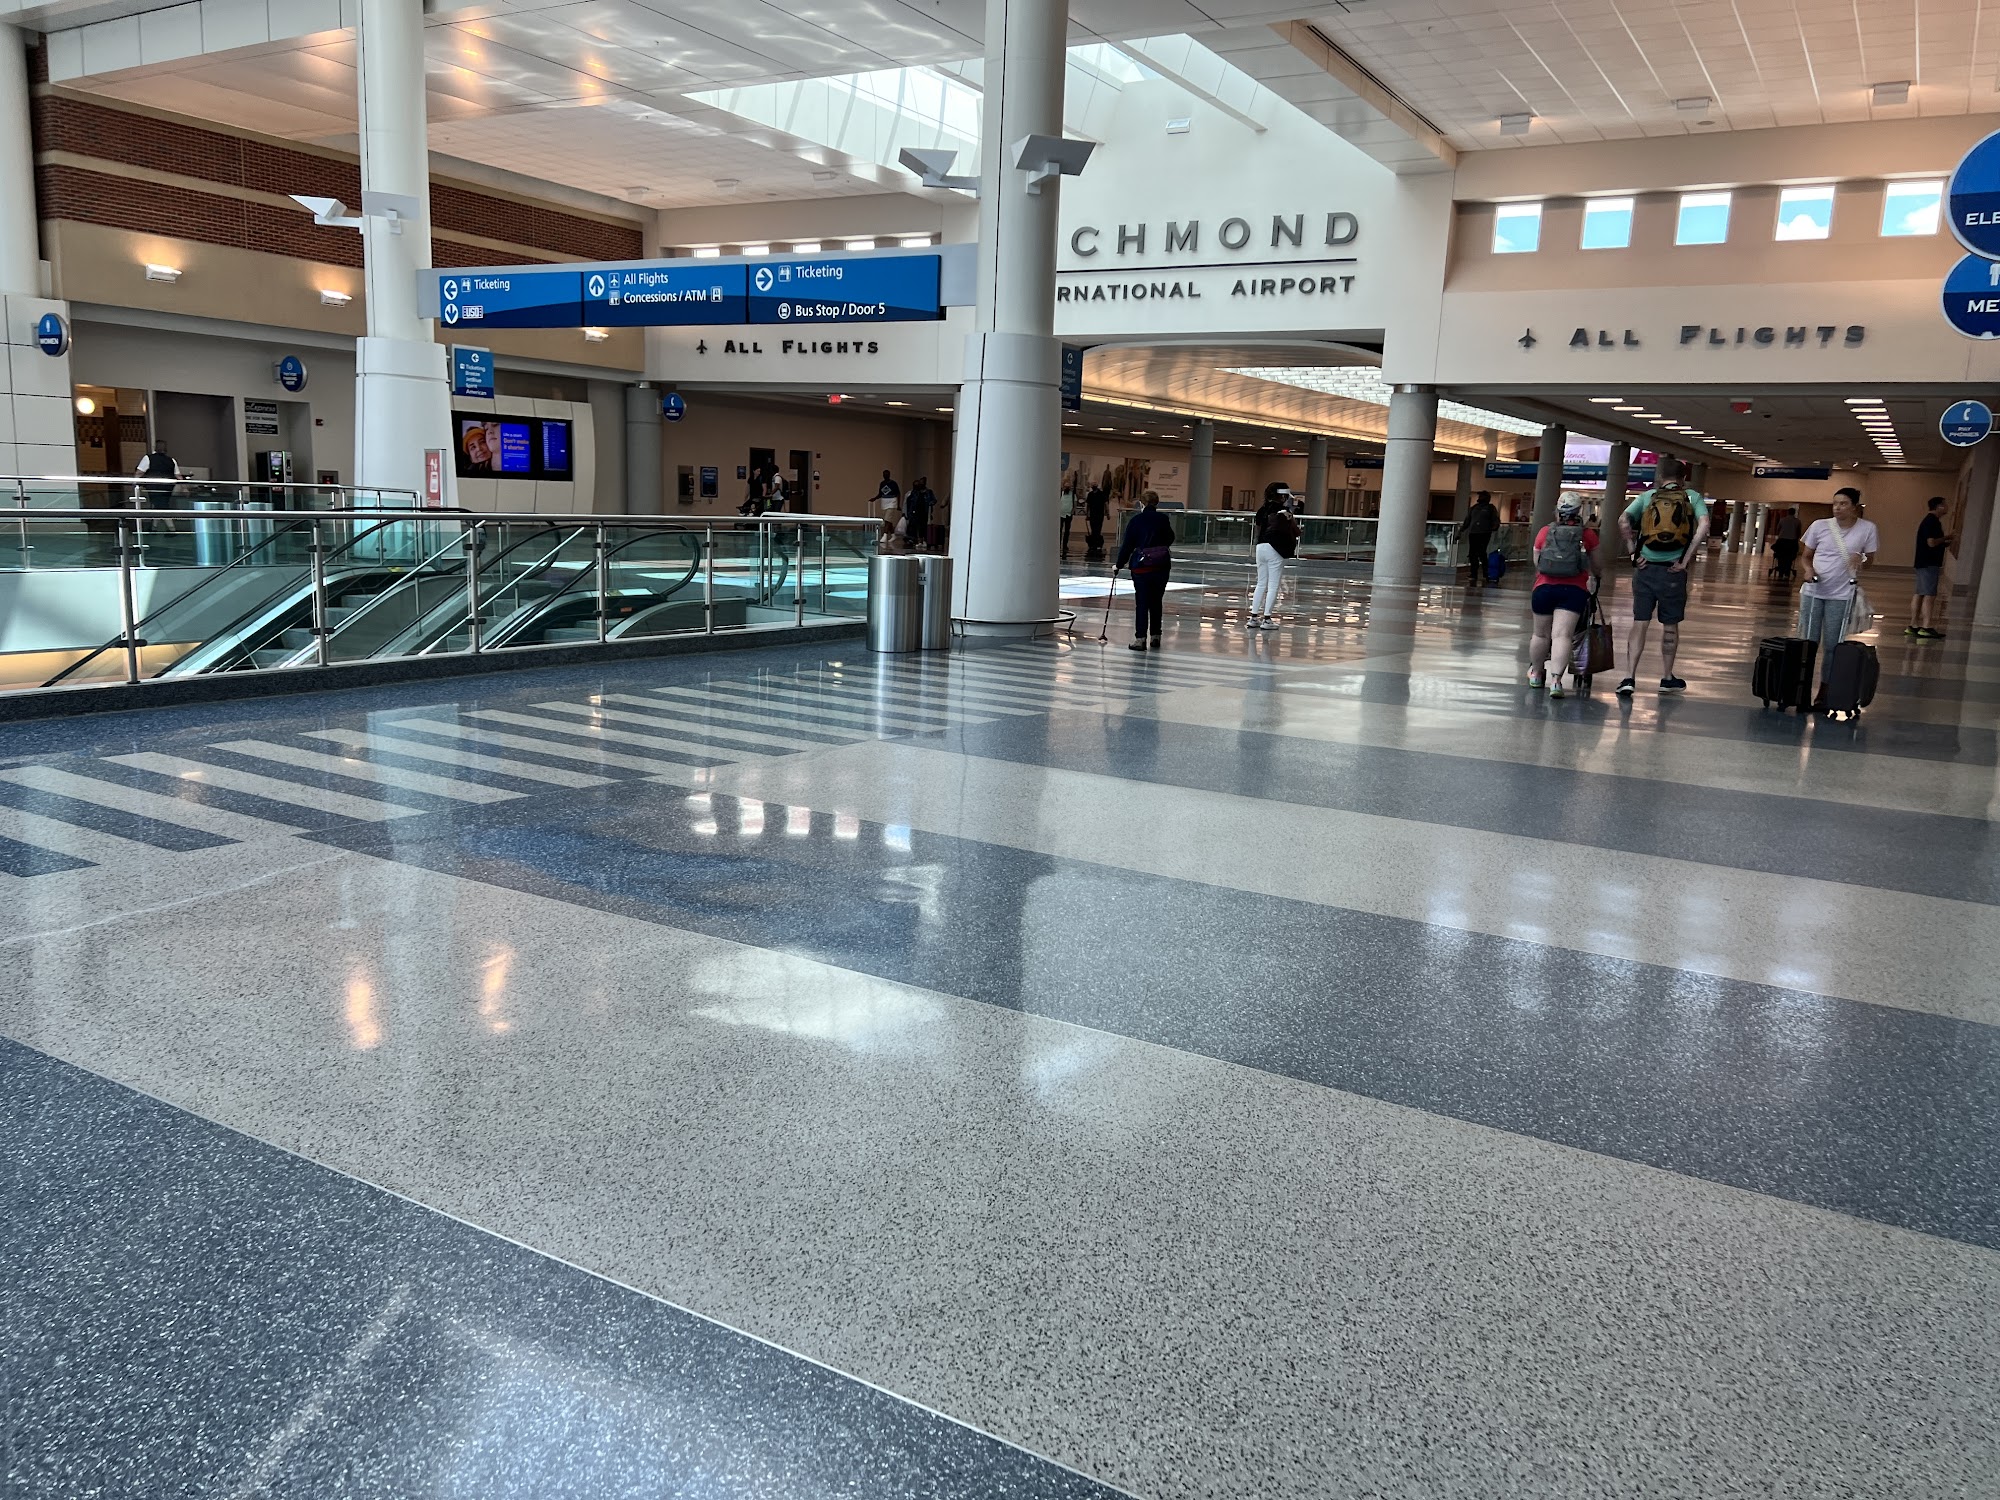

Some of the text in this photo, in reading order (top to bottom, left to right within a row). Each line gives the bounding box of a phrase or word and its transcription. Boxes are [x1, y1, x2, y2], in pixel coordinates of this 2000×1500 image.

[1070, 211, 1359, 258] CHMOND
[796, 265, 843, 279] Ticketing
[473, 278, 510, 292] Ticketing
[623, 272, 669, 287] All Flights
[1057, 275, 1355, 302] RNATIONAL AIRPORT
[623, 291, 677, 304] Concessions
[684, 289, 707, 302] ATM
[795, 305, 813, 317] Bus
[816, 304, 840, 318] Stop
[849, 303, 876, 316] Door
[878, 302, 885, 315] 5
[1966, 299, 2000, 313] ME
[40, 337, 59, 345] WOMEN
[465, 364, 486, 373] Ticketing
